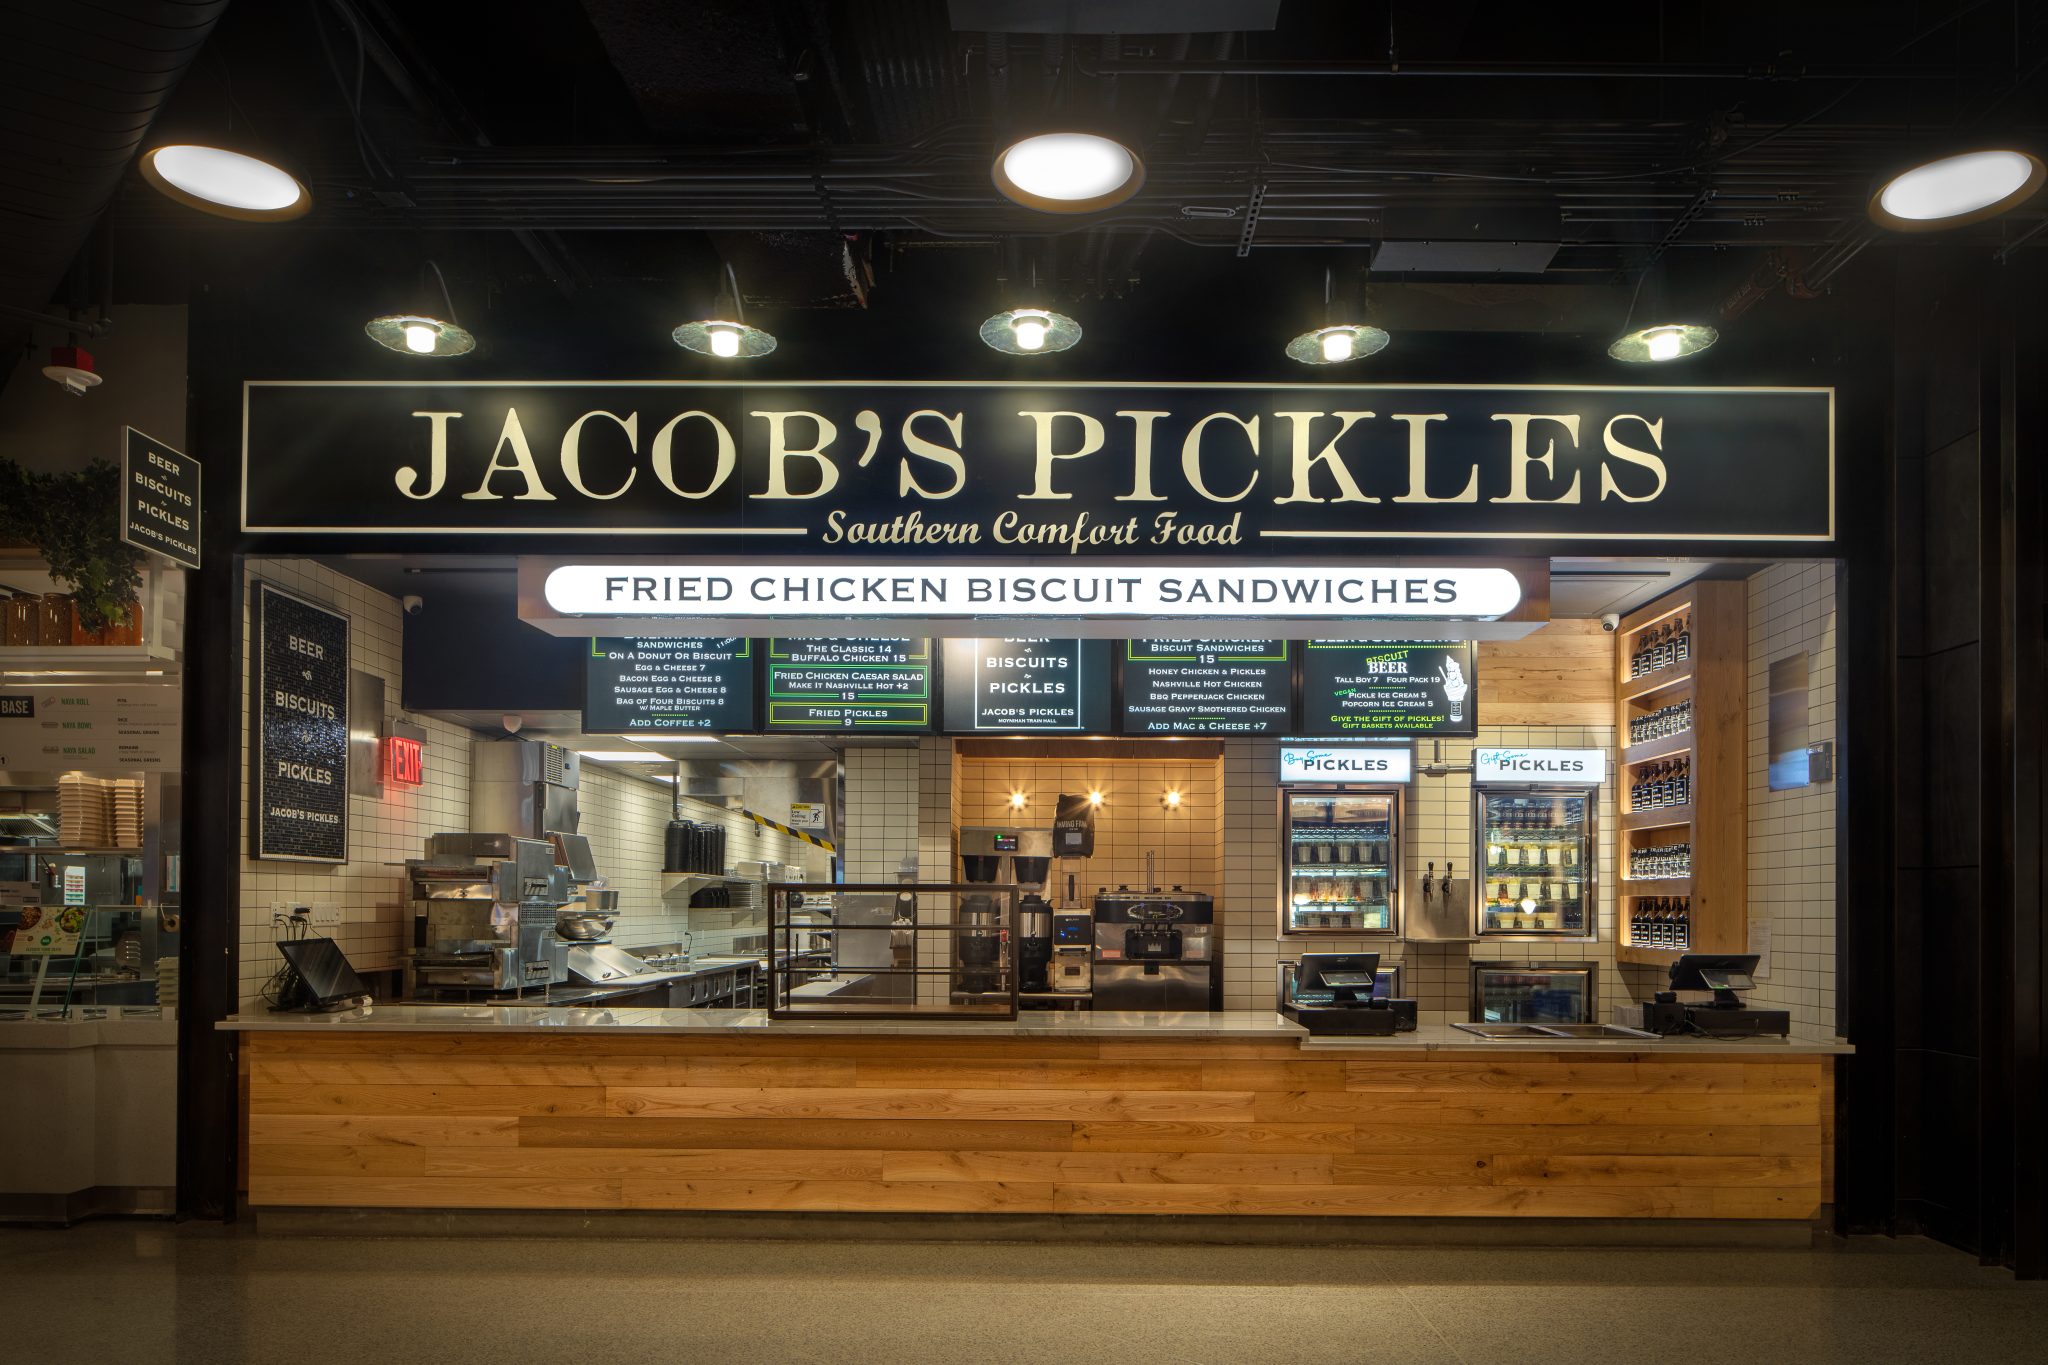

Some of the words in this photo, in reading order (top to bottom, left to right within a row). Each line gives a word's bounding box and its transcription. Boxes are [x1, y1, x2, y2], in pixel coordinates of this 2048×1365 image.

[394, 407, 966, 500] JACOB'S
[1017, 409, 1668, 504] PICKLES
[148, 452, 180, 476] BEER
[135, 472, 192, 507] BISCUITS
[138, 500, 190, 530] PICKLES
[822, 510, 981, 544] Southern
[992, 510, 1138, 554] Comfort
[1149, 511, 1243, 545] Food
[129, 522, 164, 541] JACOB'S
[165, 535, 197, 555] PICKLES
[605, 576, 733, 602] FRIED
[750, 576, 948, 603] CHICKEN
[967, 576, 1143, 603] BISCUIT
[1159, 576, 1459, 604] SANDWICHES
[289, 635, 324, 660] BEER
[831, 645, 874, 653] CLASSIC
[879, 645, 891, 653] 14
[609, 652, 624, 660] ON
[843, 654, 889, 662] CHICKEN
[893, 654, 906, 662] 15
[1199, 655, 1215, 663] 15
[986, 658, 1068, 668] BISCUITS
[1368, 662, 1408, 673] BEER
[774, 672, 803, 680] FRIED
[806, 672, 849, 680] CHICKEN
[990, 683, 1065, 693] PICKLES
[1334, 688, 1357, 696] VEGAN
[1, 700, 29, 714] BASE
[275, 691, 335, 720] BISCUITS
[845, 709, 888, 717] PICKLES
[630, 719, 651, 727] ADD
[654, 719, 695, 727] COFFEE
[698, 719, 711, 727] +2
[395, 740, 419, 783] EXIT
[1304, 760, 1388, 770] PICKLES
[1500, 760, 1584, 771] PICKLES
[277, 762, 332, 785] PICKLES
[270, 807, 305, 821] JACOB'S
[306, 811, 339, 824] PICKLES
